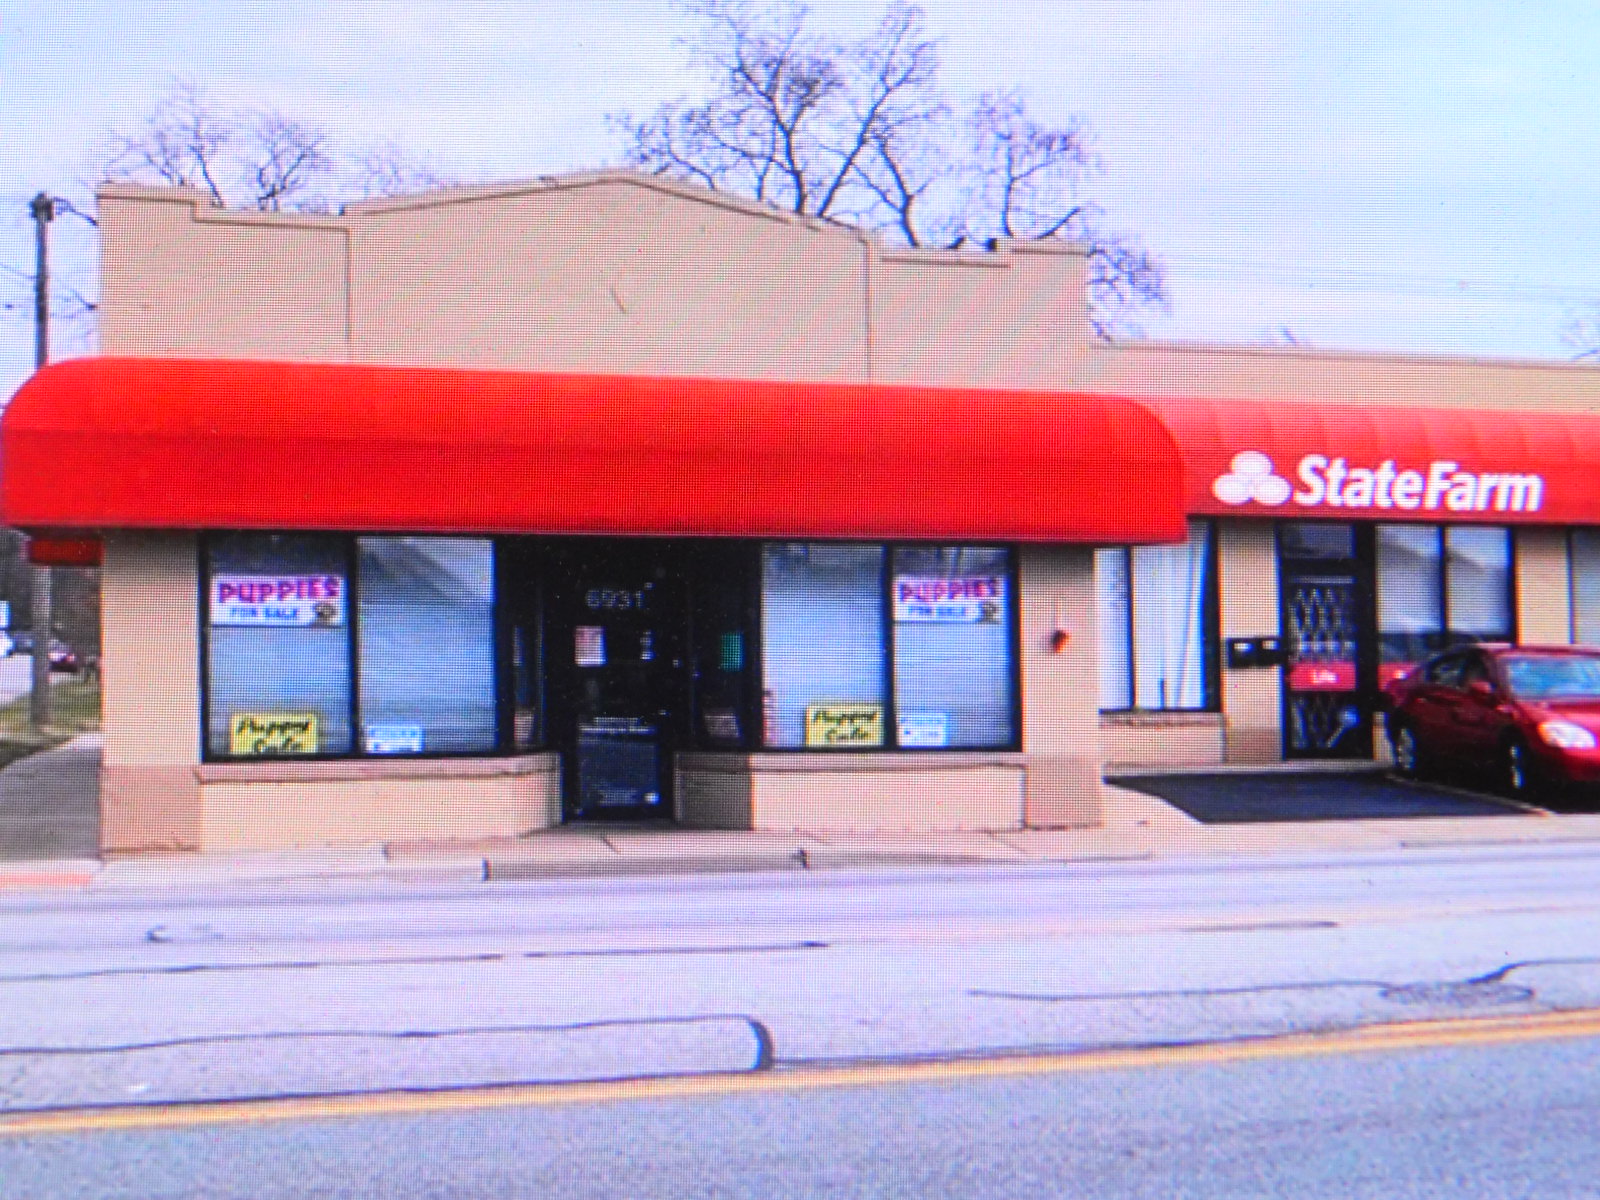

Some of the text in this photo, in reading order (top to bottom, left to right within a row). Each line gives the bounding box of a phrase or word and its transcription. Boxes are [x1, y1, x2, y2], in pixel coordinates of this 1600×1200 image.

[218, 576, 340, 604] PUPPIES
[586, 589, 645, 609] 6931
[899, 577, 997, 602] PUPPIES
[230, 607, 298, 619] FOR SALE
